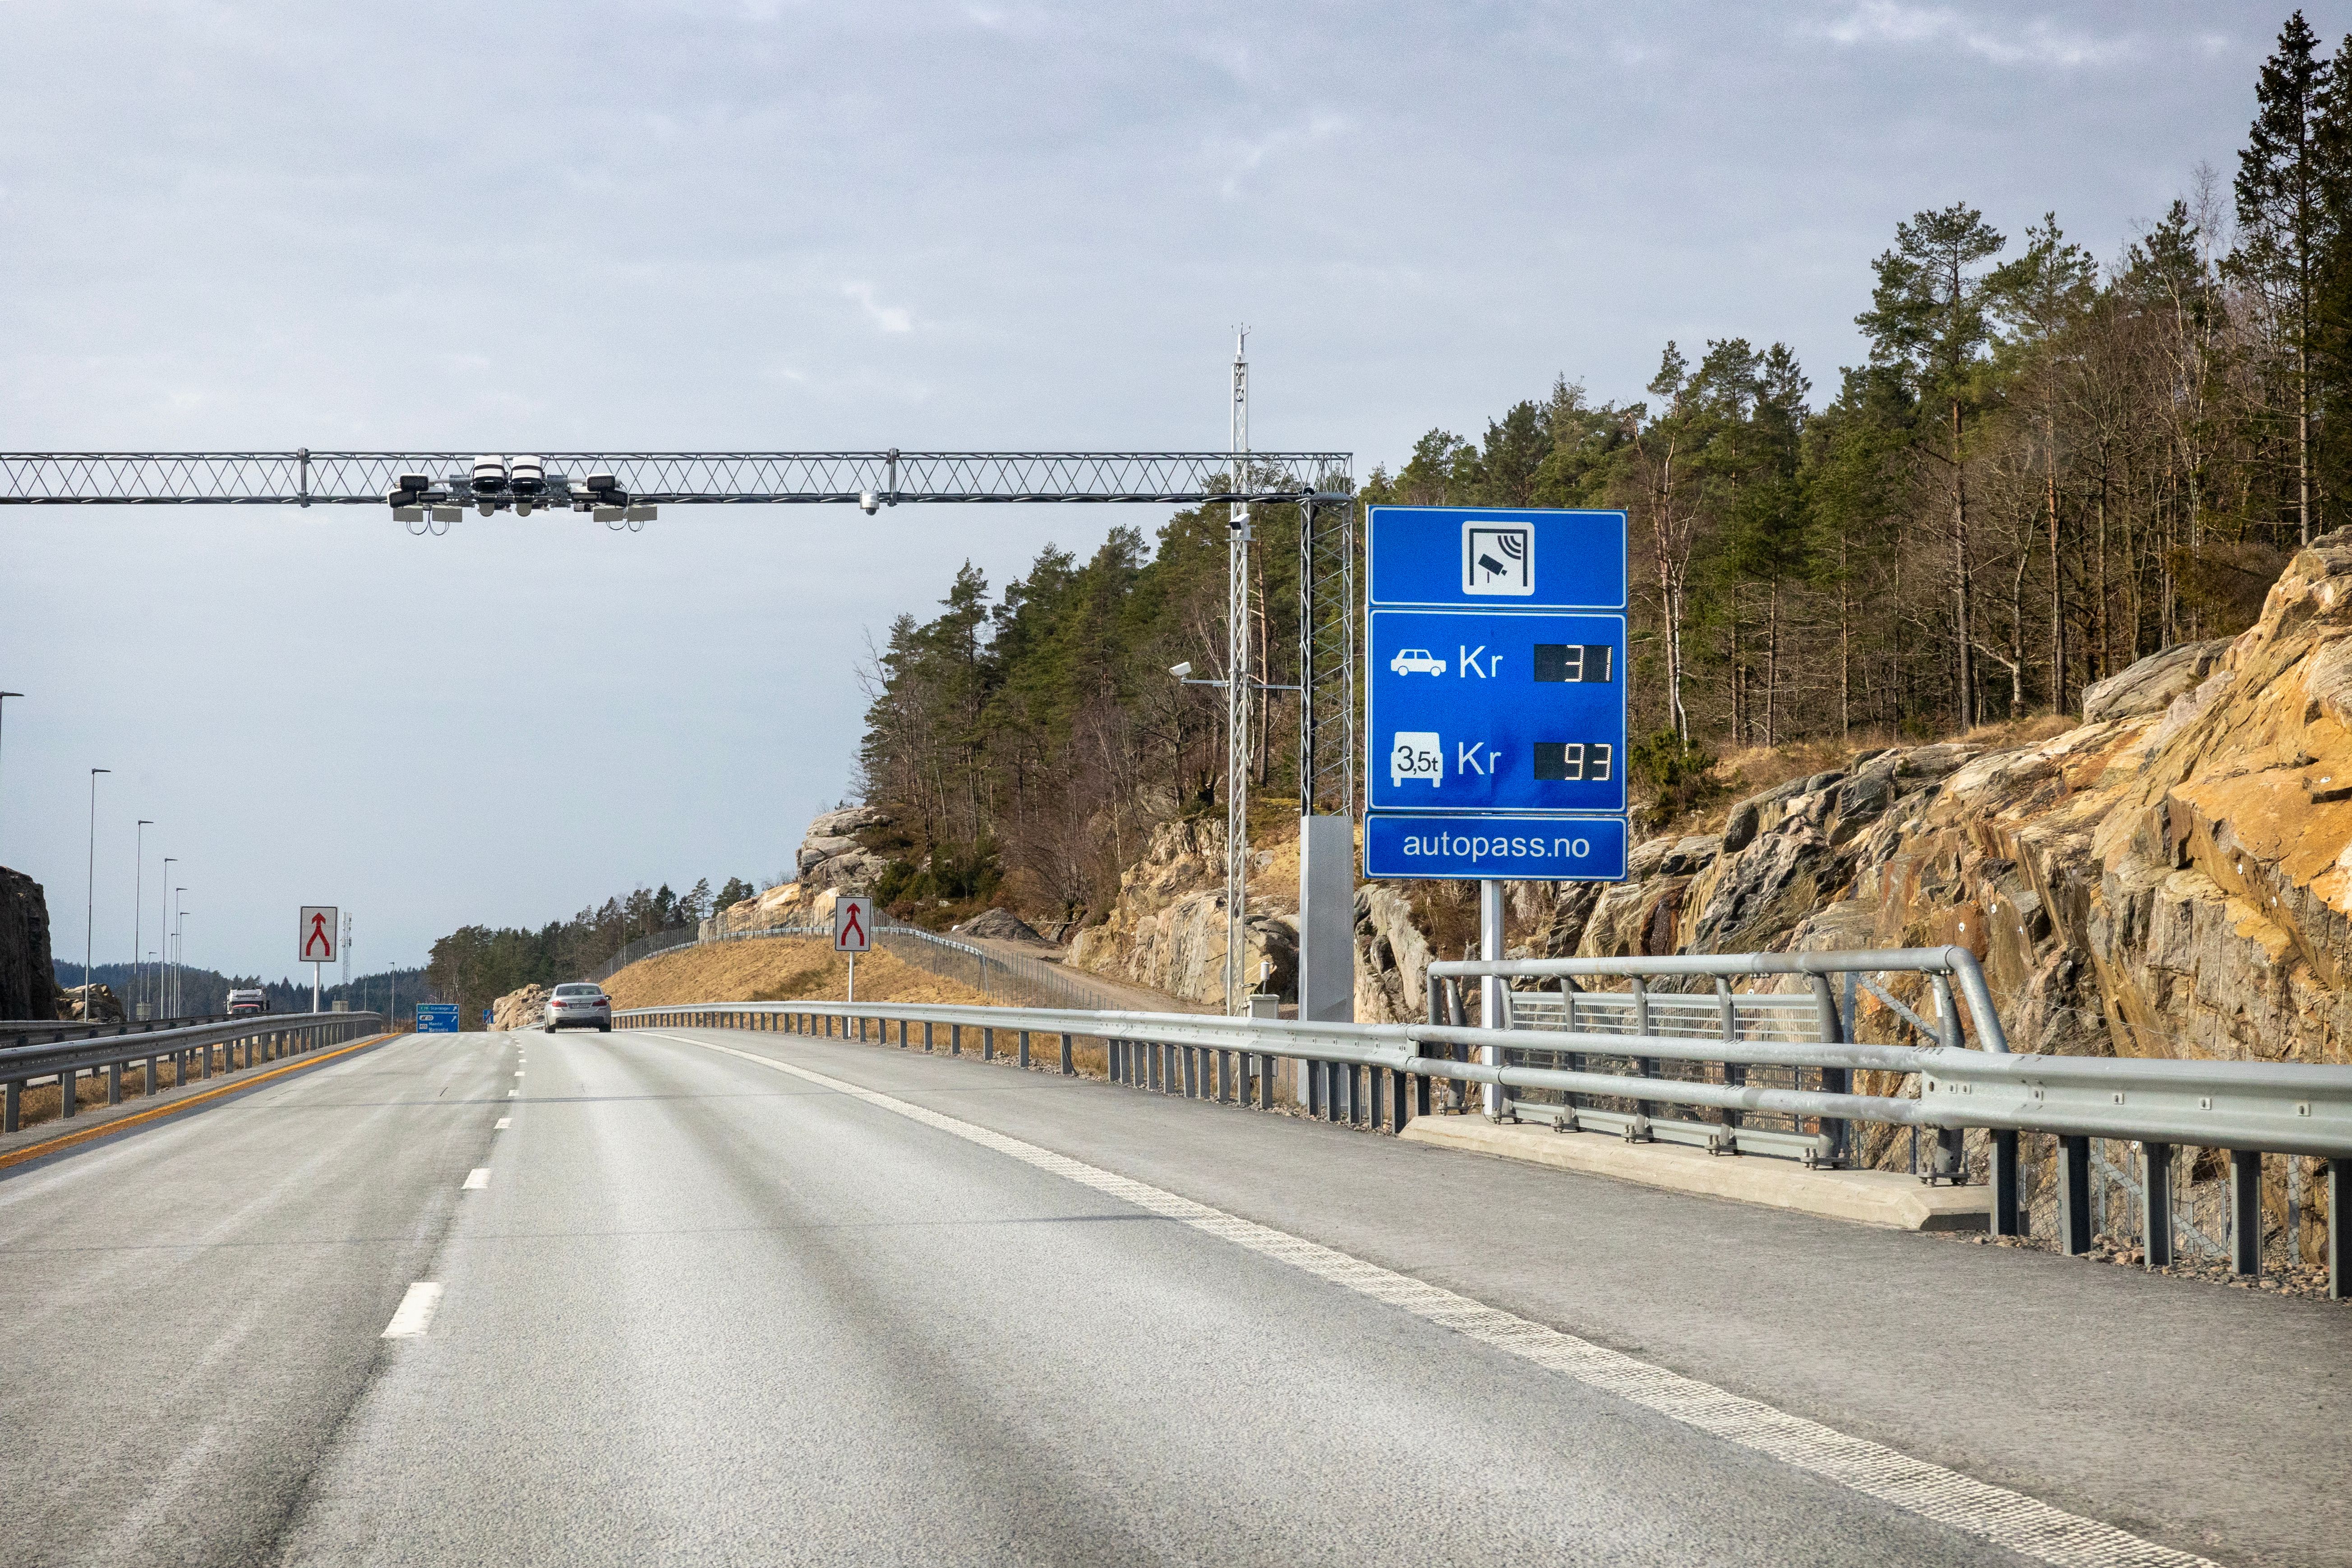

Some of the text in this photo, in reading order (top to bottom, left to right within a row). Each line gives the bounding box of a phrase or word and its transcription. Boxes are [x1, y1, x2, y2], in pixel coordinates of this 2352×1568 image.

[1460, 645, 1612, 682] Kr 31
[1397, 746, 1439, 775] 3,5t
[1458, 742, 1612, 781] Kr 93
[1403, 831, 1590, 862] autopass.no
